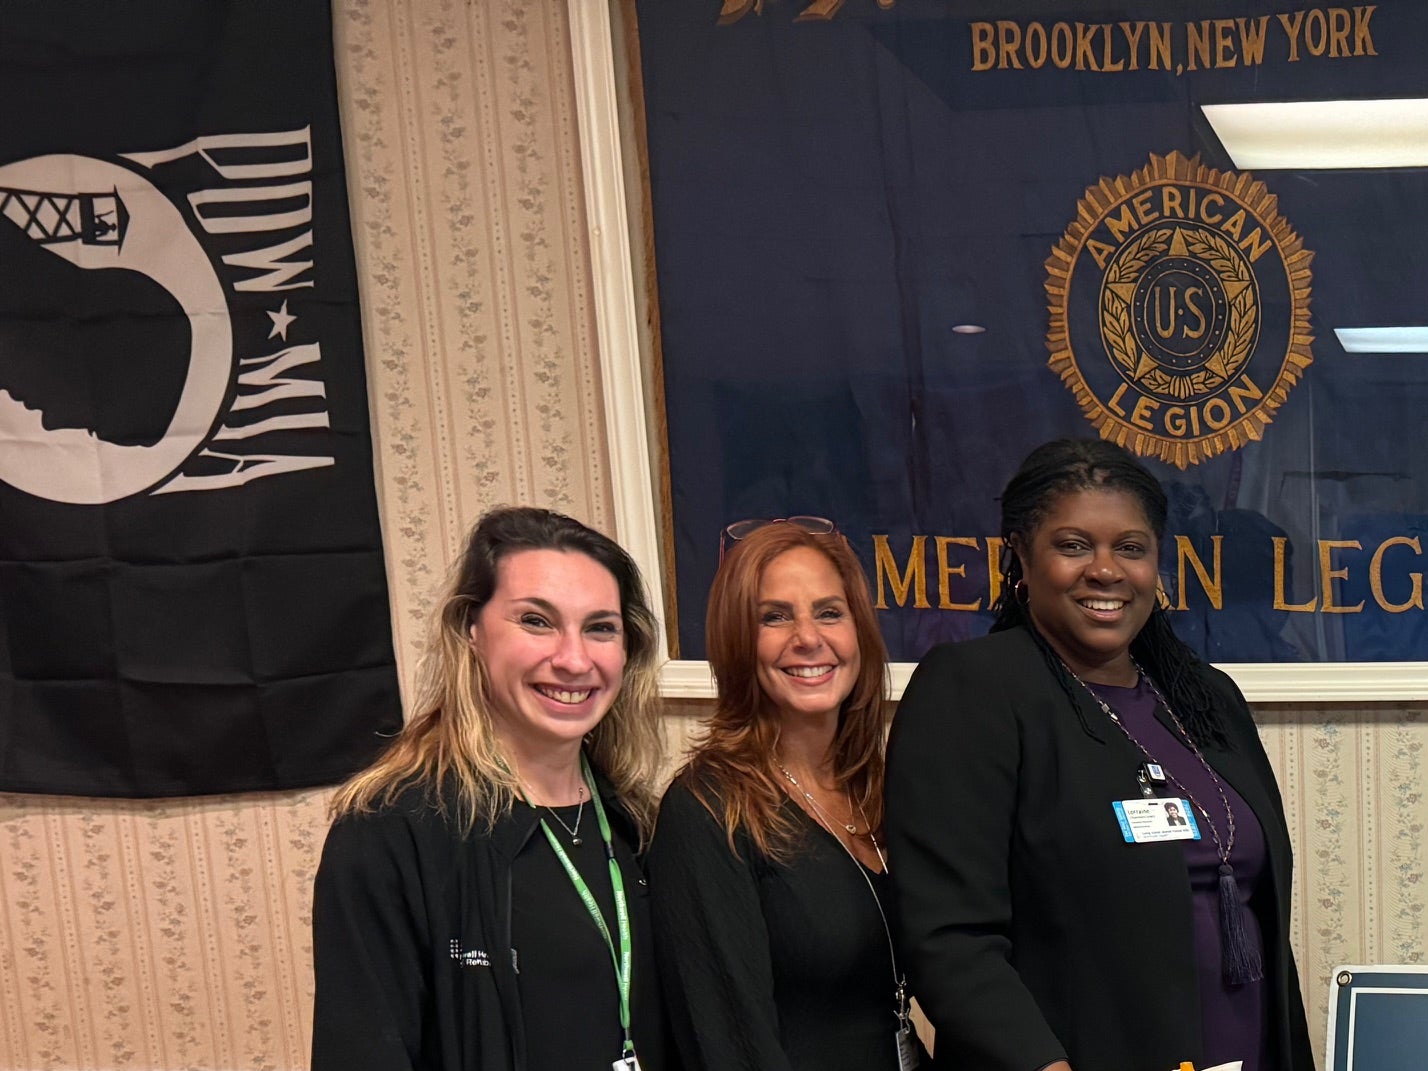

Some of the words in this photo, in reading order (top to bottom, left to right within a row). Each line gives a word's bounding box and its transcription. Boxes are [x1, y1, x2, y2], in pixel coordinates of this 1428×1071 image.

[1277, 6, 1379, 62] YORK
[116, 124, 314, 292] POW
[1086, 186, 1273, 271] AMERICAN
[149, 341, 335, 495] MIA
[1109, 373, 1263, 437] LEGION
[616, 891, 628, 920] Northwell
